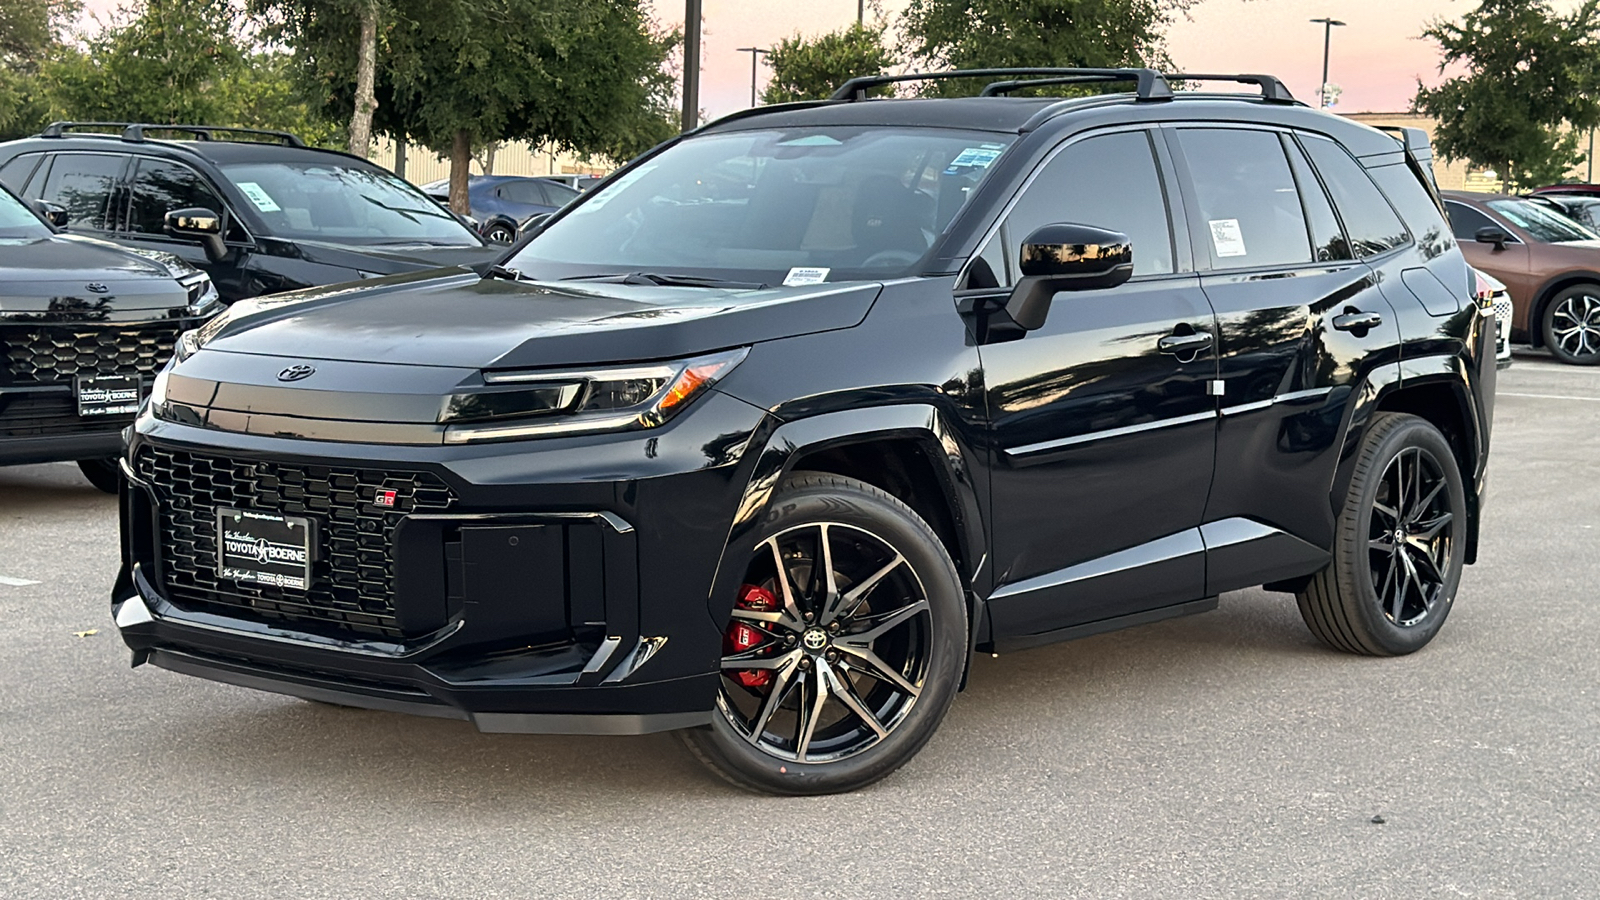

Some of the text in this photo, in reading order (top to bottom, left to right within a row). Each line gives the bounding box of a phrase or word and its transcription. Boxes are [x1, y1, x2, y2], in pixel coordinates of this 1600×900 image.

[225, 541, 306, 562] TOYOTA BOERNE
[257, 574, 276, 583] TOYOTA
